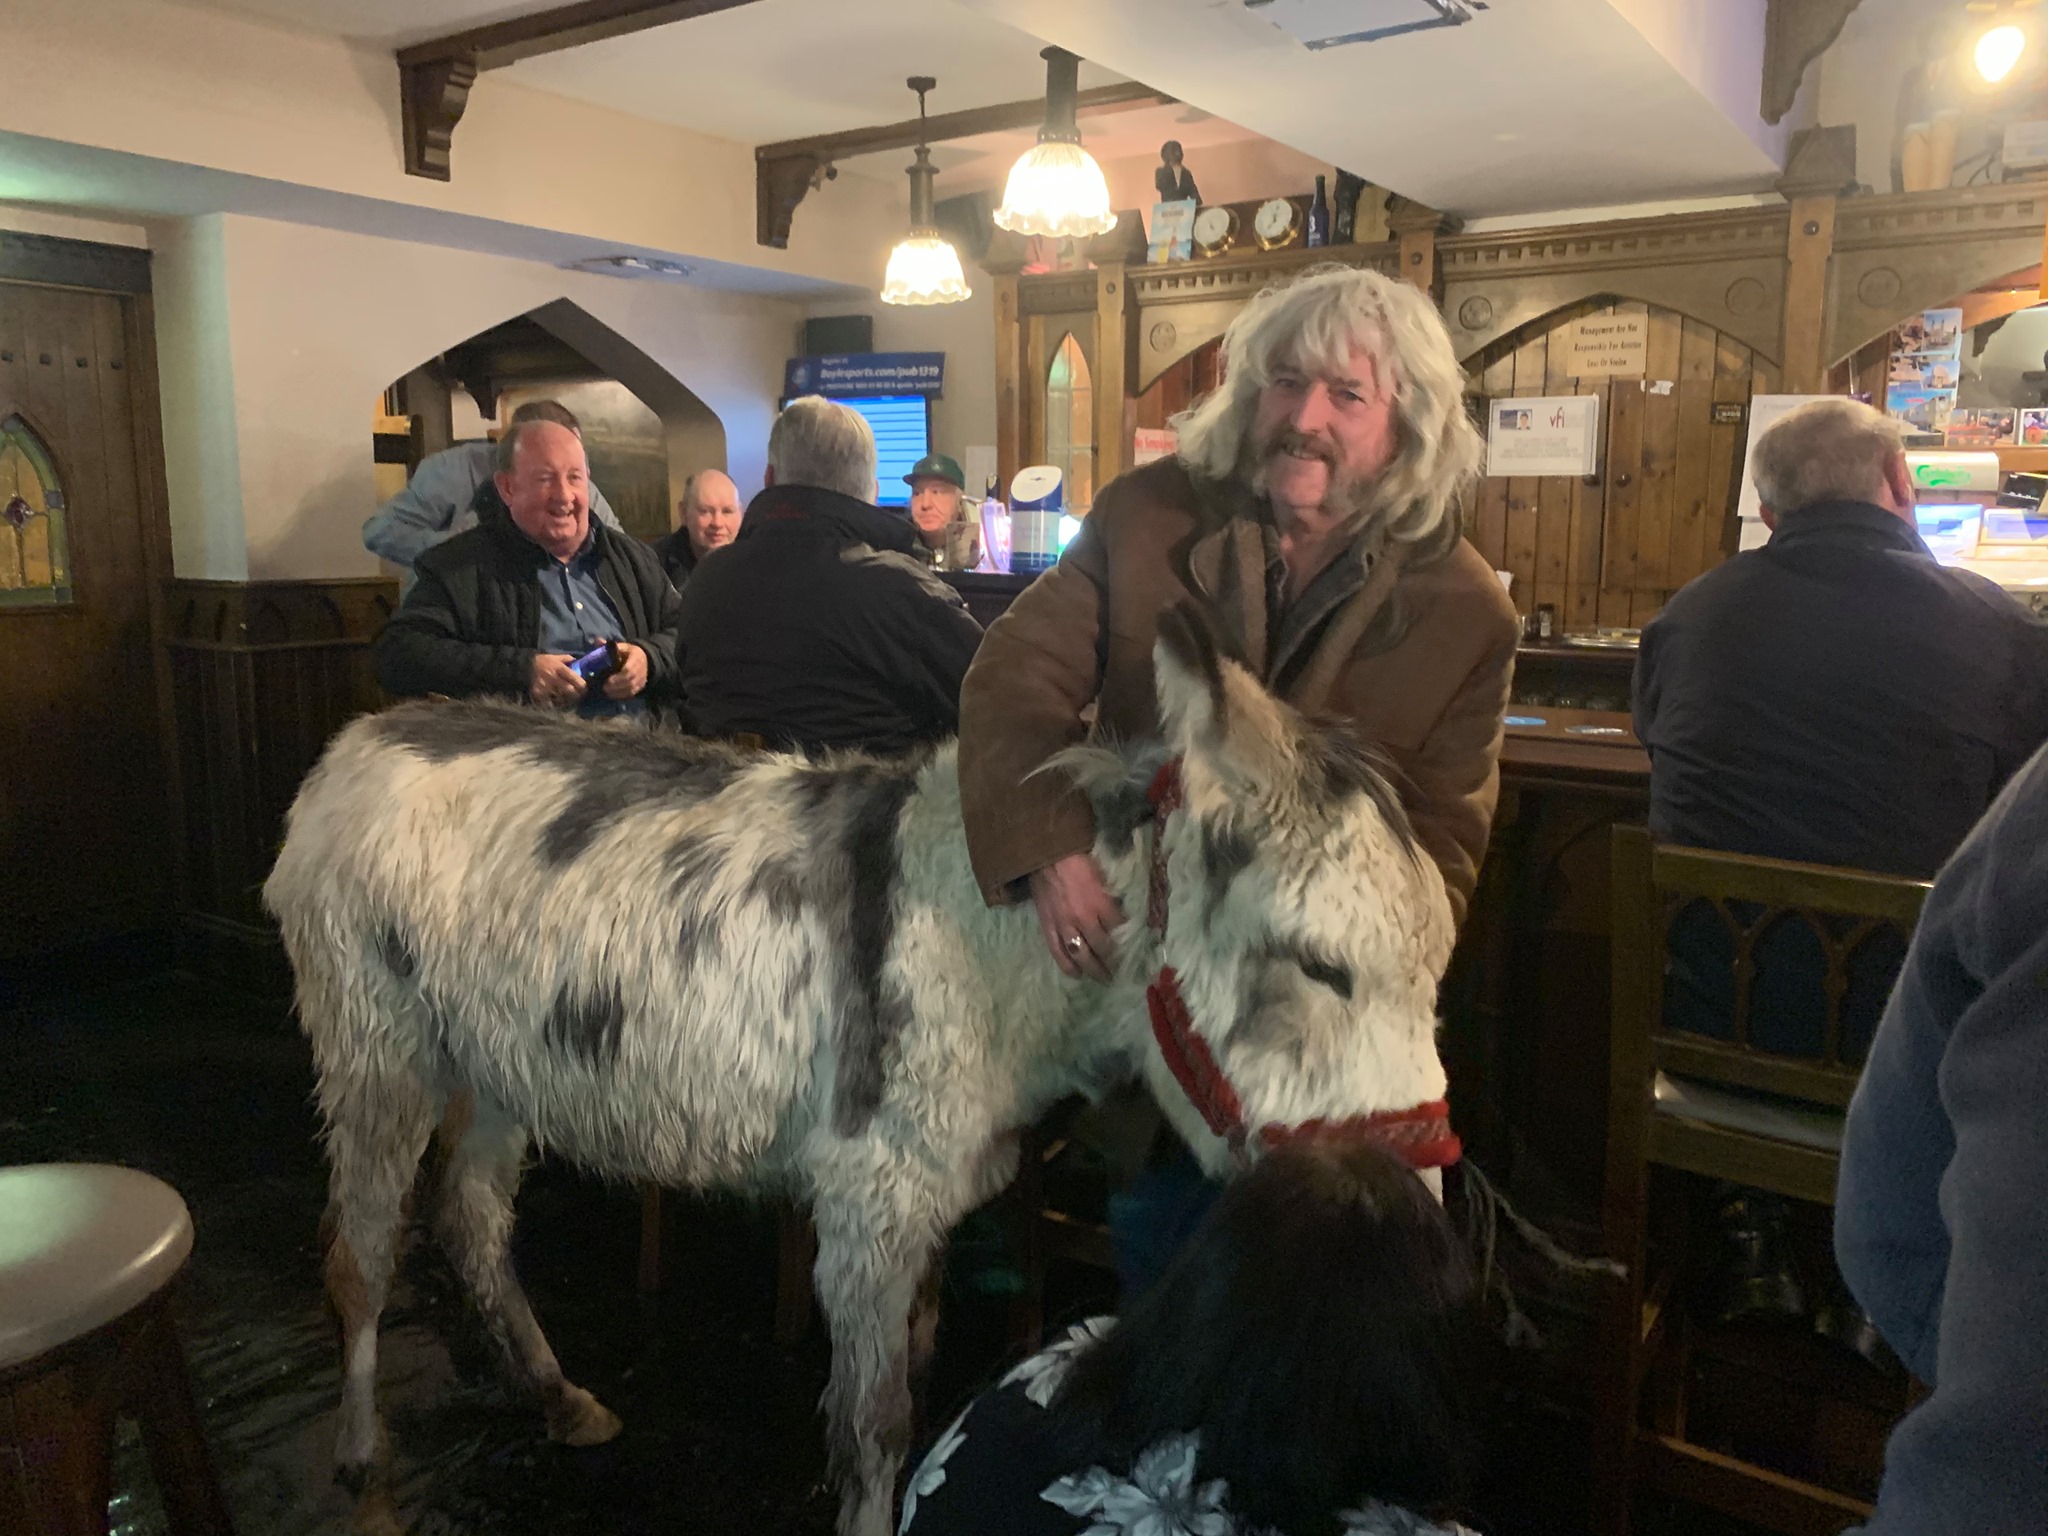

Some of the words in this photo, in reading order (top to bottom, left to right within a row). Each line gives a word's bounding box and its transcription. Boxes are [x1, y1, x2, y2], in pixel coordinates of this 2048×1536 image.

[1579, 325, 1615, 337] Management
[1616, 323, 1626, 334] Are
[1628, 323, 1638, 333] Not
[1573, 342, 1608, 353] Responsible
[1609, 341, 1619, 351] For
[1600, 357, 1608, 367] Or
